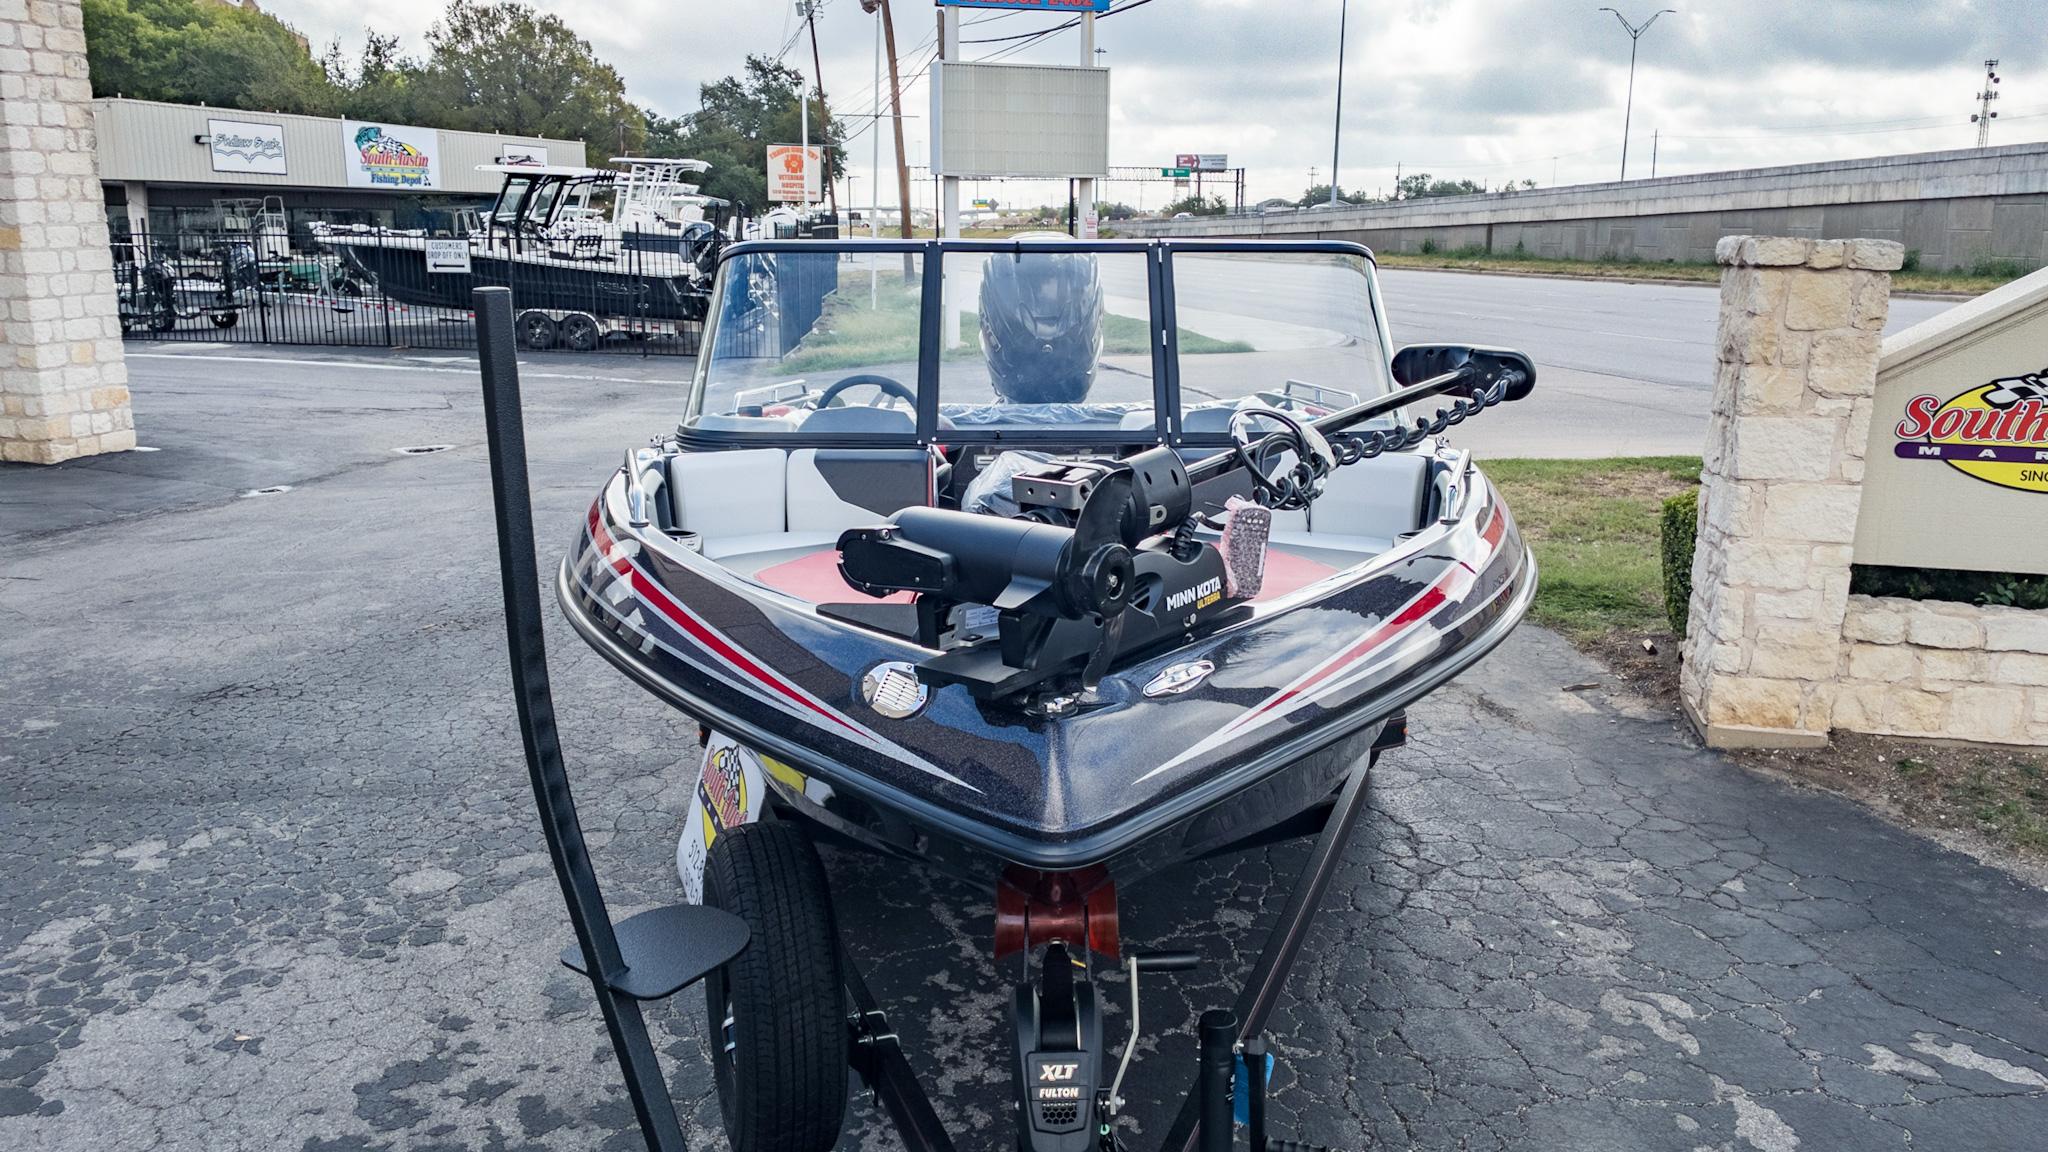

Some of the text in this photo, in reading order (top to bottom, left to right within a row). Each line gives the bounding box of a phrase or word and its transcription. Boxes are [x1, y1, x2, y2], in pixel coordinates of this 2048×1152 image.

[360, 148, 429, 167] South Austin
[371, 173, 422, 186] Fishing Depot
[431, 242, 463, 250] CUSTOMERS
[453, 251, 468, 259] ONLY
[1166, 576, 1221, 611] MINN KOTA
[1039, 1064, 1079, 1082] XLT
[1039, 1087, 1079, 1099] FULTON
